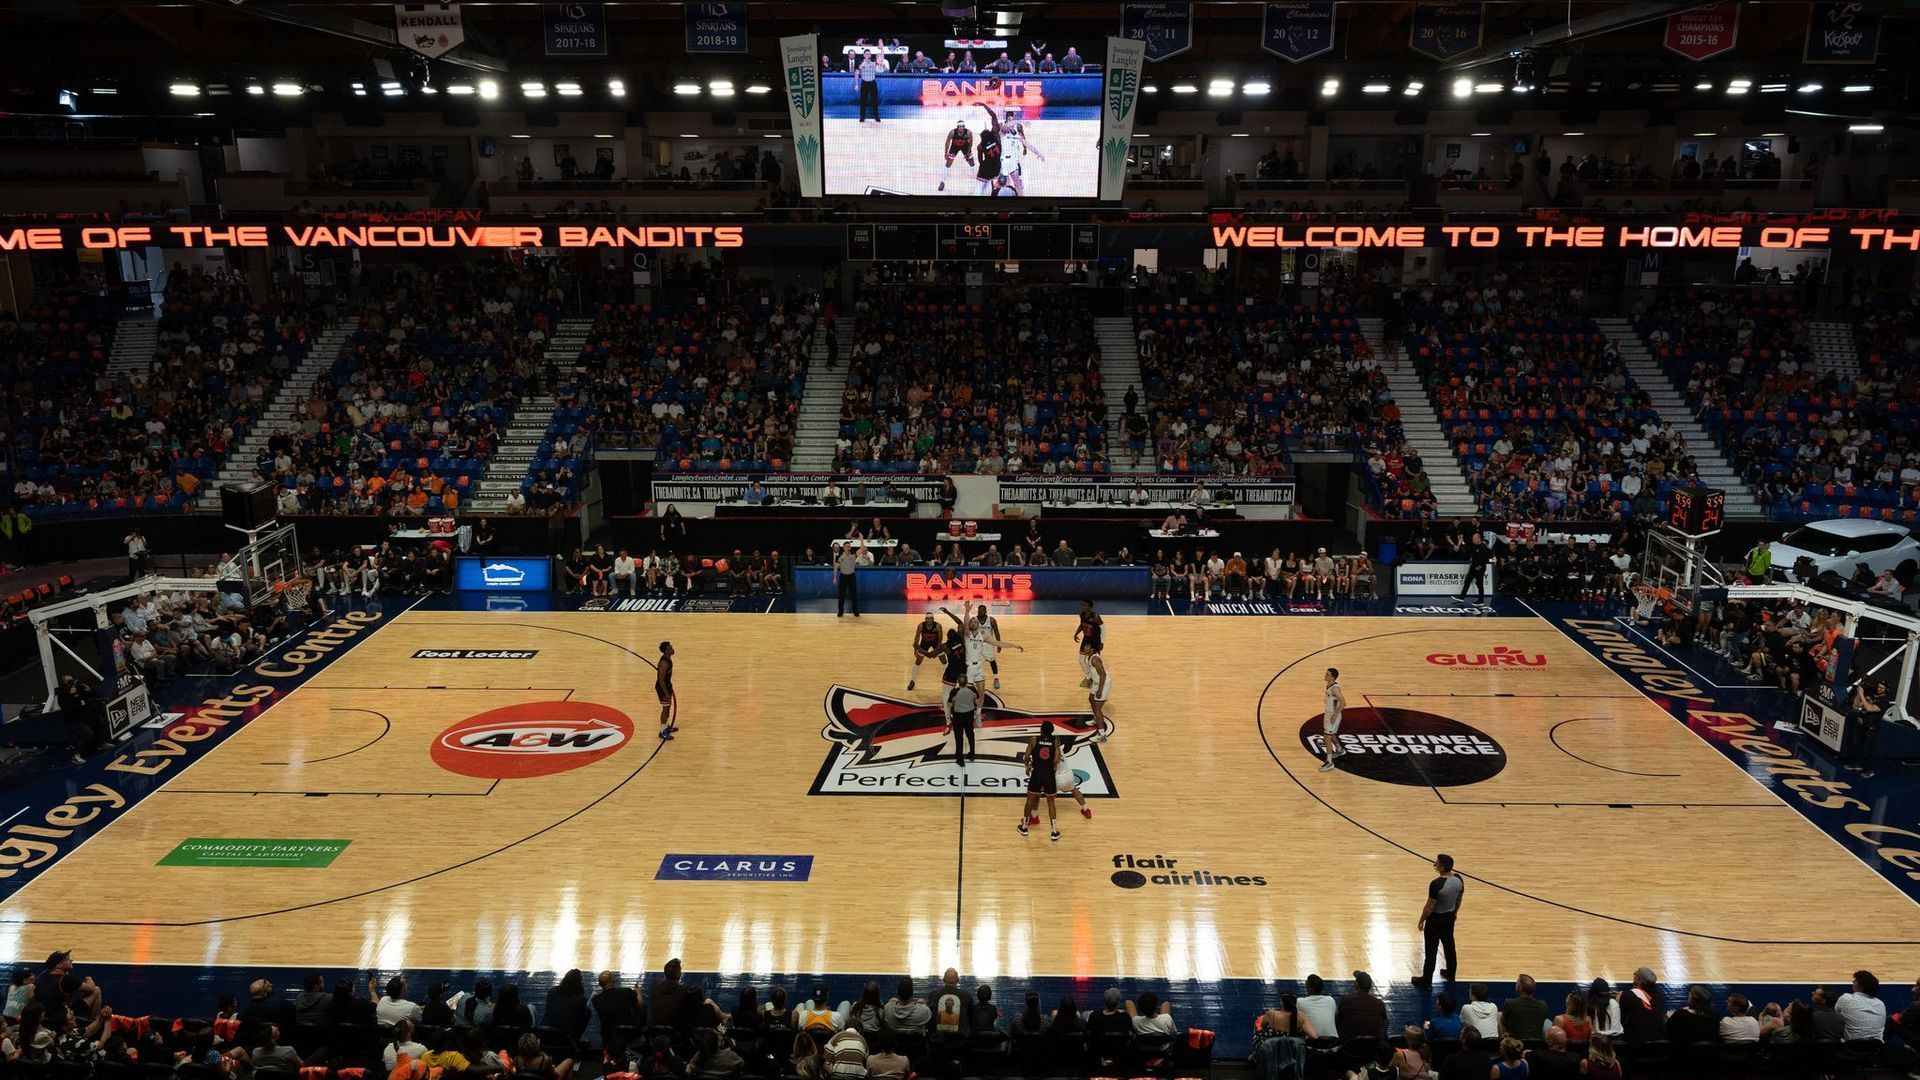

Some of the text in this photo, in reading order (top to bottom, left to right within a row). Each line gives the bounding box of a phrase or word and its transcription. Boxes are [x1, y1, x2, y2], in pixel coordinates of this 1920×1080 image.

[401, 16, 457, 27] KENDALL
[554, 23, 596, 34] SPARTANS
[696, 21, 737, 32] SPARTANS
[1677, 23, 1724, 32] CHAMPIONS
[1132, 28, 1176, 39] 20 11
[1273, 28, 1320, 40] 20 12
[1680, 34, 1719, 46] 2015-16
[1824, 30, 1864, 49] KidSport
[556, 38, 597, 49] 2017-18
[697, 36, 738, 47] 2018-19
[82, 226, 152, 248] OF
[169, 226, 269, 248] THE
[283, 225, 544, 248] VANCOUVER
[560, 225, 744, 248] BANDITS
[964, 225, 990, 237] 9:59
[1212, 226, 1426, 248] WELCOME
[1441, 226, 1501, 248] TO
[1516, 226, 1605, 248] THE
[1619, 226, 1743, 248] HOME
[1758, 227, 1832, 249] OF
[303, 253, 314, 270] S
[633, 252, 648, 271] Q
[1644, 252, 1659, 270] M
[671, 474, 749, 482] LangleyEventsCentre.com
[1015, 475, 1093, 483] LangleyEventsCentre.com
[655, 486, 701, 500] THEBANDITS.CA
[1001, 488, 1047, 501] THEBANDITS.CA
[1245, 489, 1292, 502] THEBANDITS.CA
[1674, 492, 1692, 509] 9:59
[1705, 494, 1724, 508] 9:59
[1671, 504, 1687, 529] 24
[1702, 509, 1719, 531] 24
[906, 573, 1033, 590] BANDITS
[1401, 575, 1425, 583] RONA
[615, 598, 680, 611] MOBILE
[1207, 603, 1247, 614] WATCH
[1250, 603, 1279, 614] LIVE
[254, 609, 383, 681] Centre
[416, 650, 534, 660] Foot Locker
[1424, 653, 1548, 667] GURU
[1560, 618, 1716, 704] Langley
[130, 701, 148, 717] ERA
[104, 682, 276, 777] Events
[1822, 725, 1841, 742] ERA
[462, 731, 618, 748] A&W
[1338, 733, 1492, 746] SENTINEL
[1345, 744, 1500, 756] STORAGE
[1686, 708, 1872, 812] Events
[181, 844, 342, 854] COMMODITY PARTNERS
[673, 860, 797, 873] CLARUS
[1111, 854, 1179, 869] flair
[1151, 870, 1269, 887] airlines
